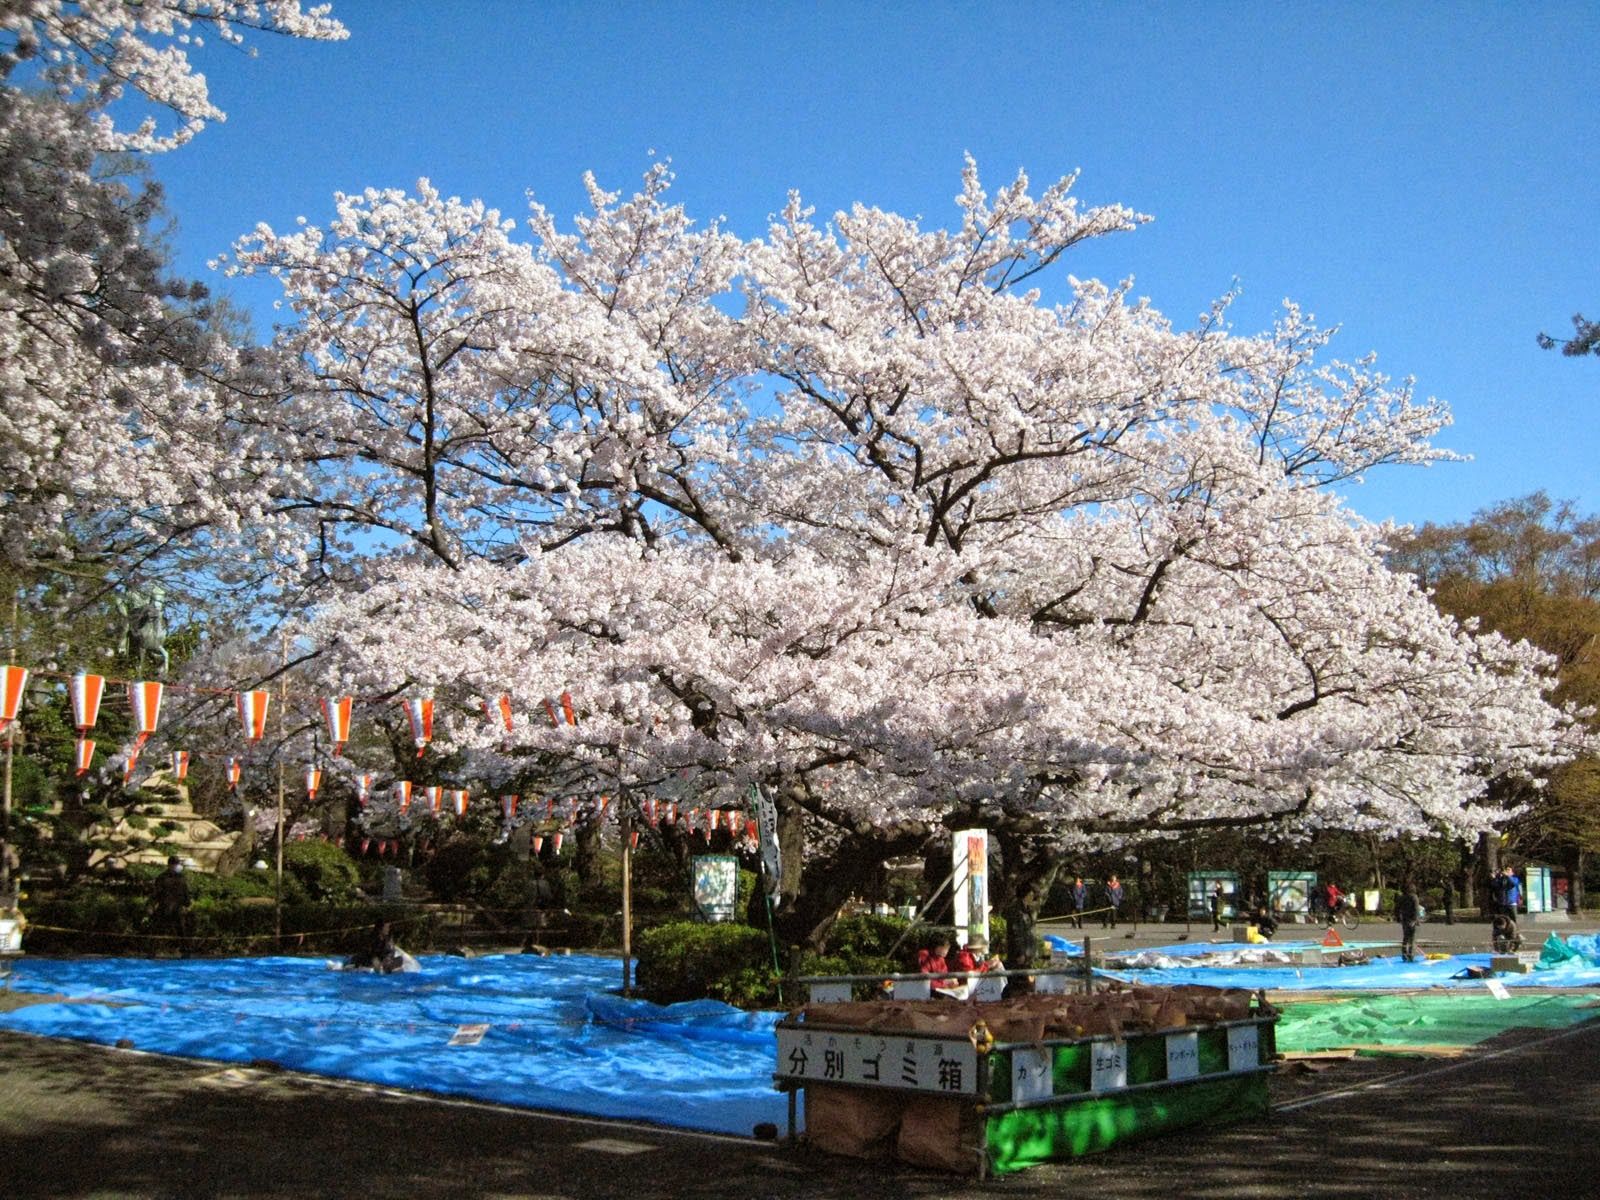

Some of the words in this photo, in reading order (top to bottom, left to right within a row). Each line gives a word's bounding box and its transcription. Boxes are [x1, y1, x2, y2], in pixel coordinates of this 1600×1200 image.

[788, 1048, 963, 1091] 分別ゴミ箱
[1096, 1055, 1121, 1071] 生ゴミ
[1017, 1064, 1047, 1081] カン
